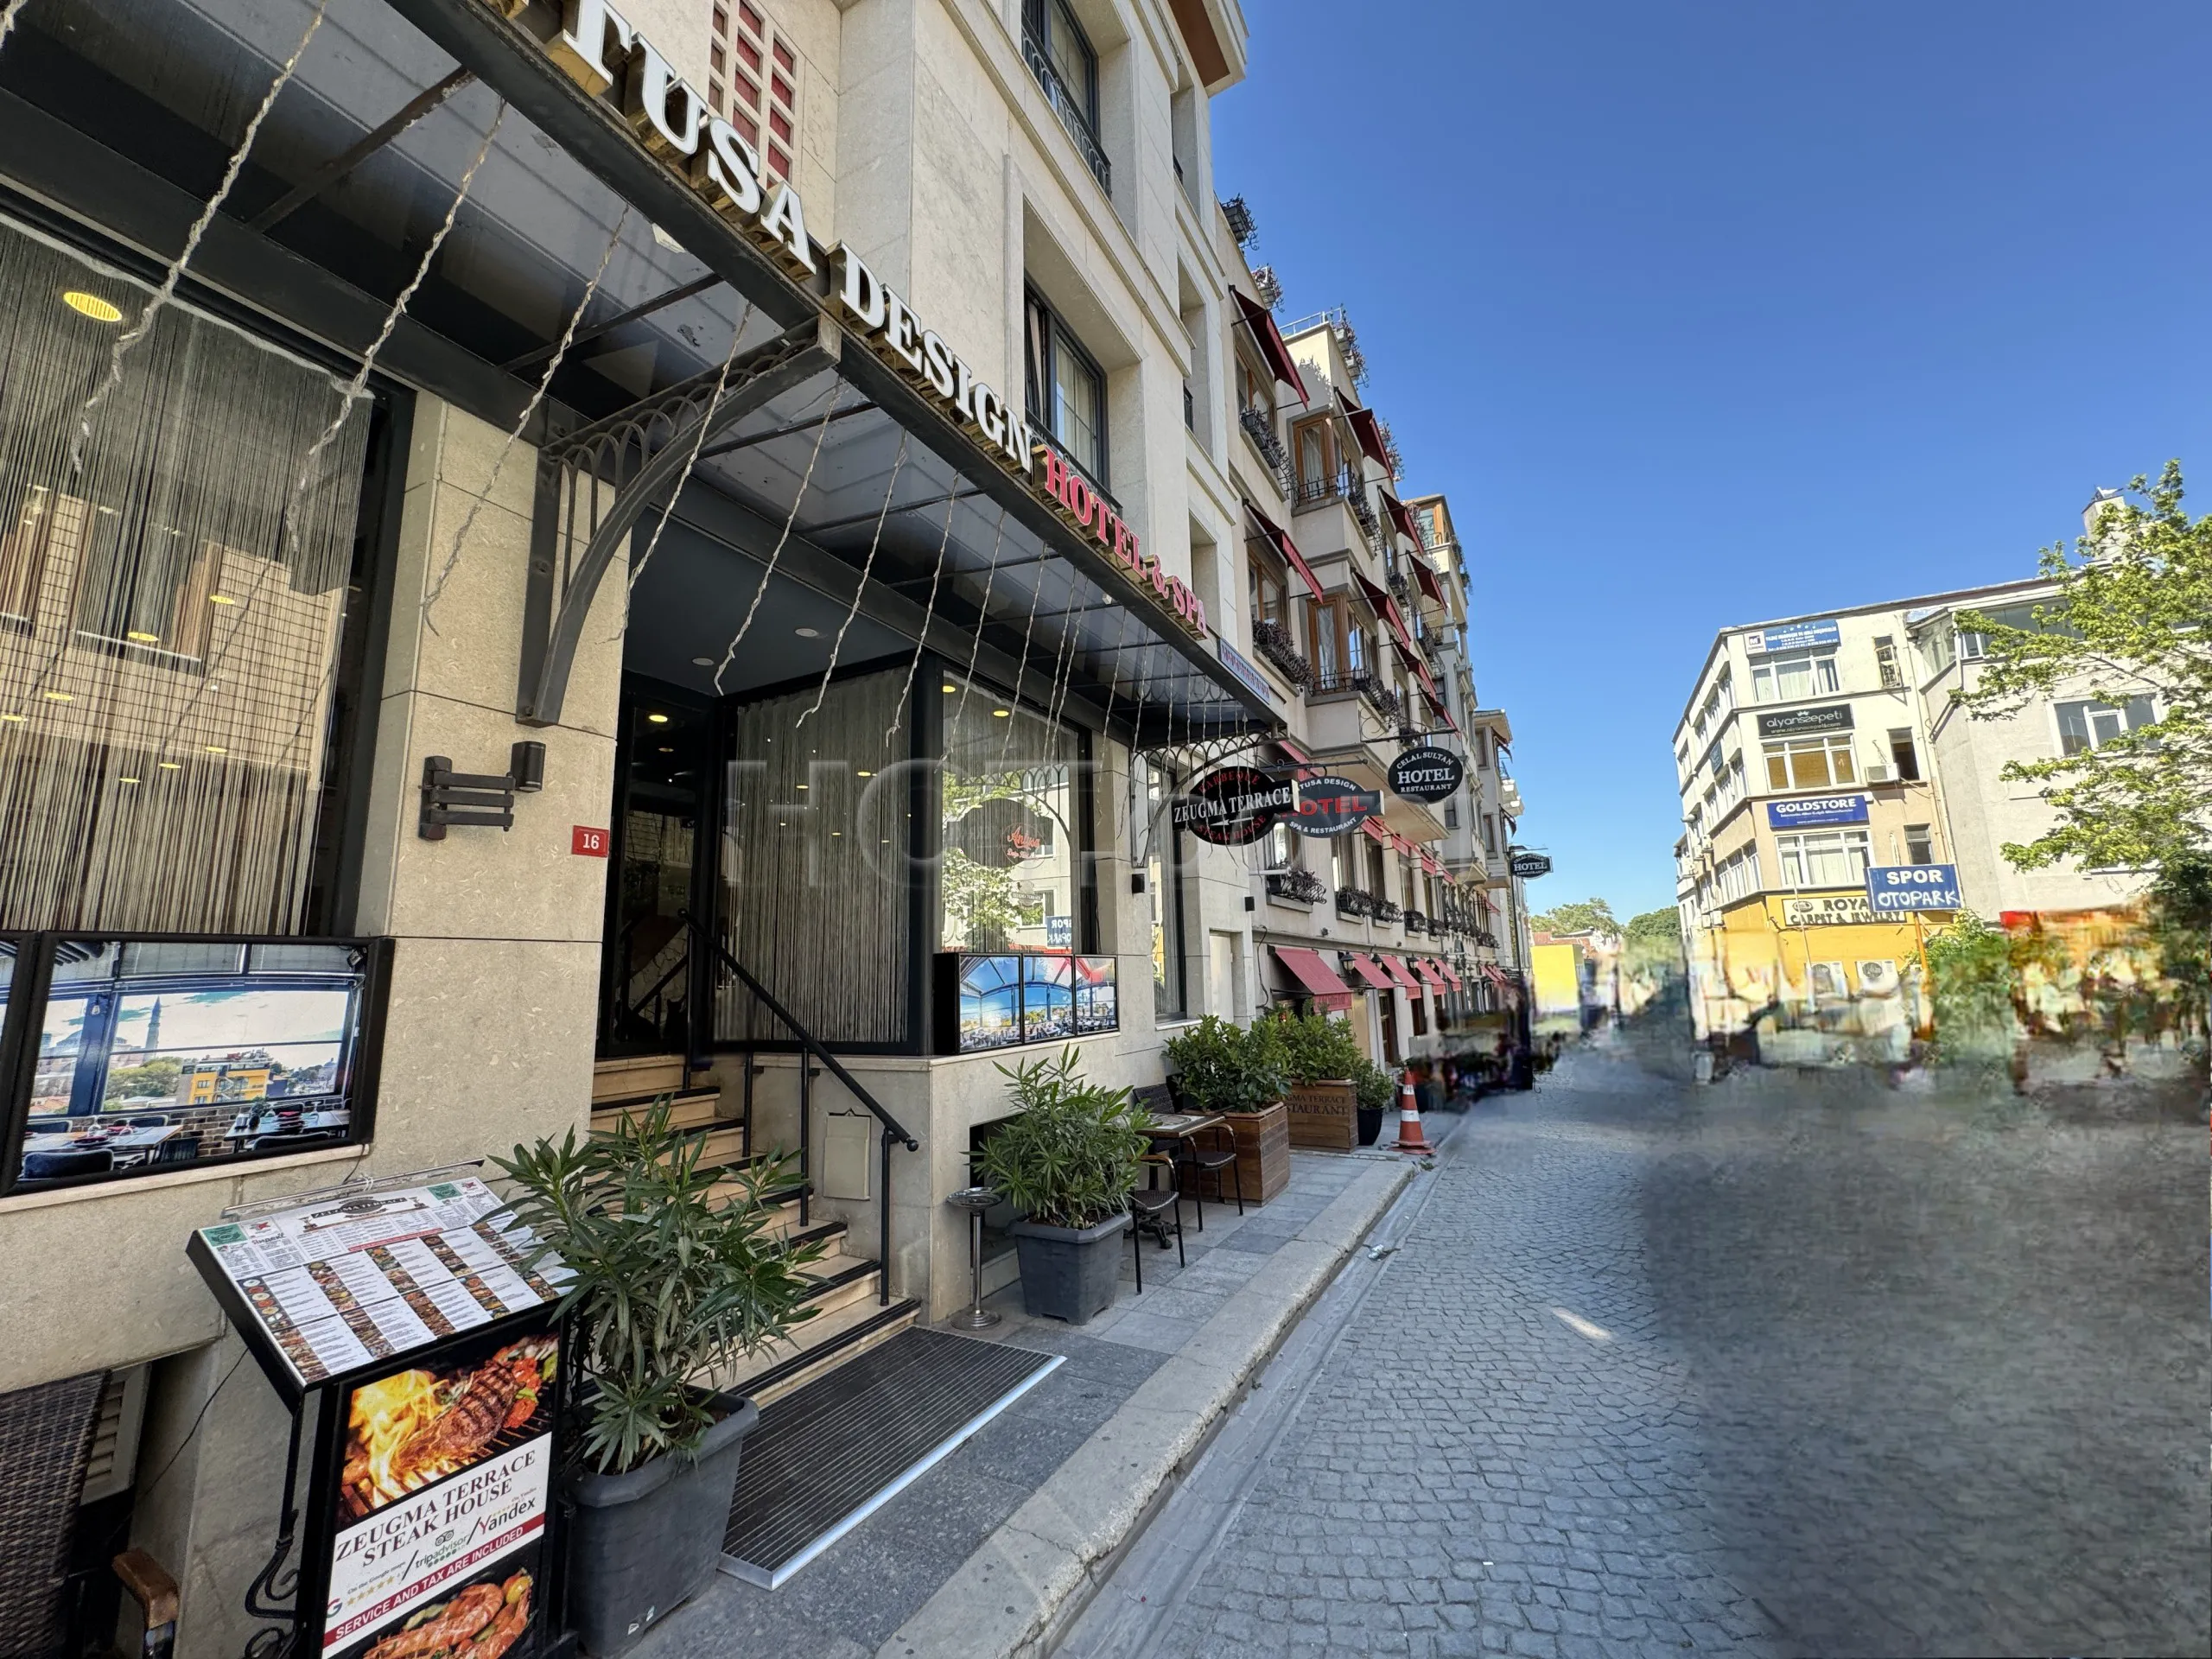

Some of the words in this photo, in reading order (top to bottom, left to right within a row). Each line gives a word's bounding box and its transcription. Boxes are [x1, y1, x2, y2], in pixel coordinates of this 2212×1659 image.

[562, 0, 817, 276] TUSA
[839, 242, 1033, 474] DESIGN
[1044, 448, 1148, 578] HOTEL
[1152, 554, 1169, 600] &
[1173, 575, 1208, 634] SPA
[1396, 753, 1422, 769] CELAL
[1422, 751, 1453, 766] SULTAN
[1300, 779, 1322, 790] TUSA
[1324, 779, 1357, 791] DESIGN
[1397, 767, 1455, 785] HOTEL
[1401, 783, 1452, 792] RESTAURANT
[1174, 799, 1228, 823] ZEUGMA
[1229, 787, 1291, 813] TERRACE
[1281, 795, 1367, 818] OTEL
[1776, 798, 1857, 813] GOLDSTORE
[1198, 824, 1230, 841] STEAK
[1233, 815, 1266, 841] HOUSE
[1289, 821, 1301, 830] SPA
[1311, 817, 1357, 834] RESTAURANT
[583, 834, 600, 849] 16
[1514, 861, 1547, 871] HOTEL
[1887, 869, 1943, 885] SPOR
[1824, 899, 1868, 912] ROYA
[1878, 890, 1960, 907] OTOPARK
[1790, 913, 1832, 925] CARPET
[335, 1500, 438, 1562] ZEUGMA
[443, 1451, 537, 1509] TERRACE
[363, 1515, 439, 1567] STEAK
[444, 1478, 512, 1526] HOUSE
[479, 1497, 536, 1535] Yandex
[415, 1535, 469, 1570] tripadvisor
[336, 1603, 391, 1639] SERVICE
[393, 1585, 419, 1605] AND
[420, 1570, 444, 1591] TAX
[447, 1556, 470, 1578] ARE
[472, 1526, 524, 1561] INCLUDED
[369, 1570, 390, 1585] Google
[327, 1598, 342, 1618] G
